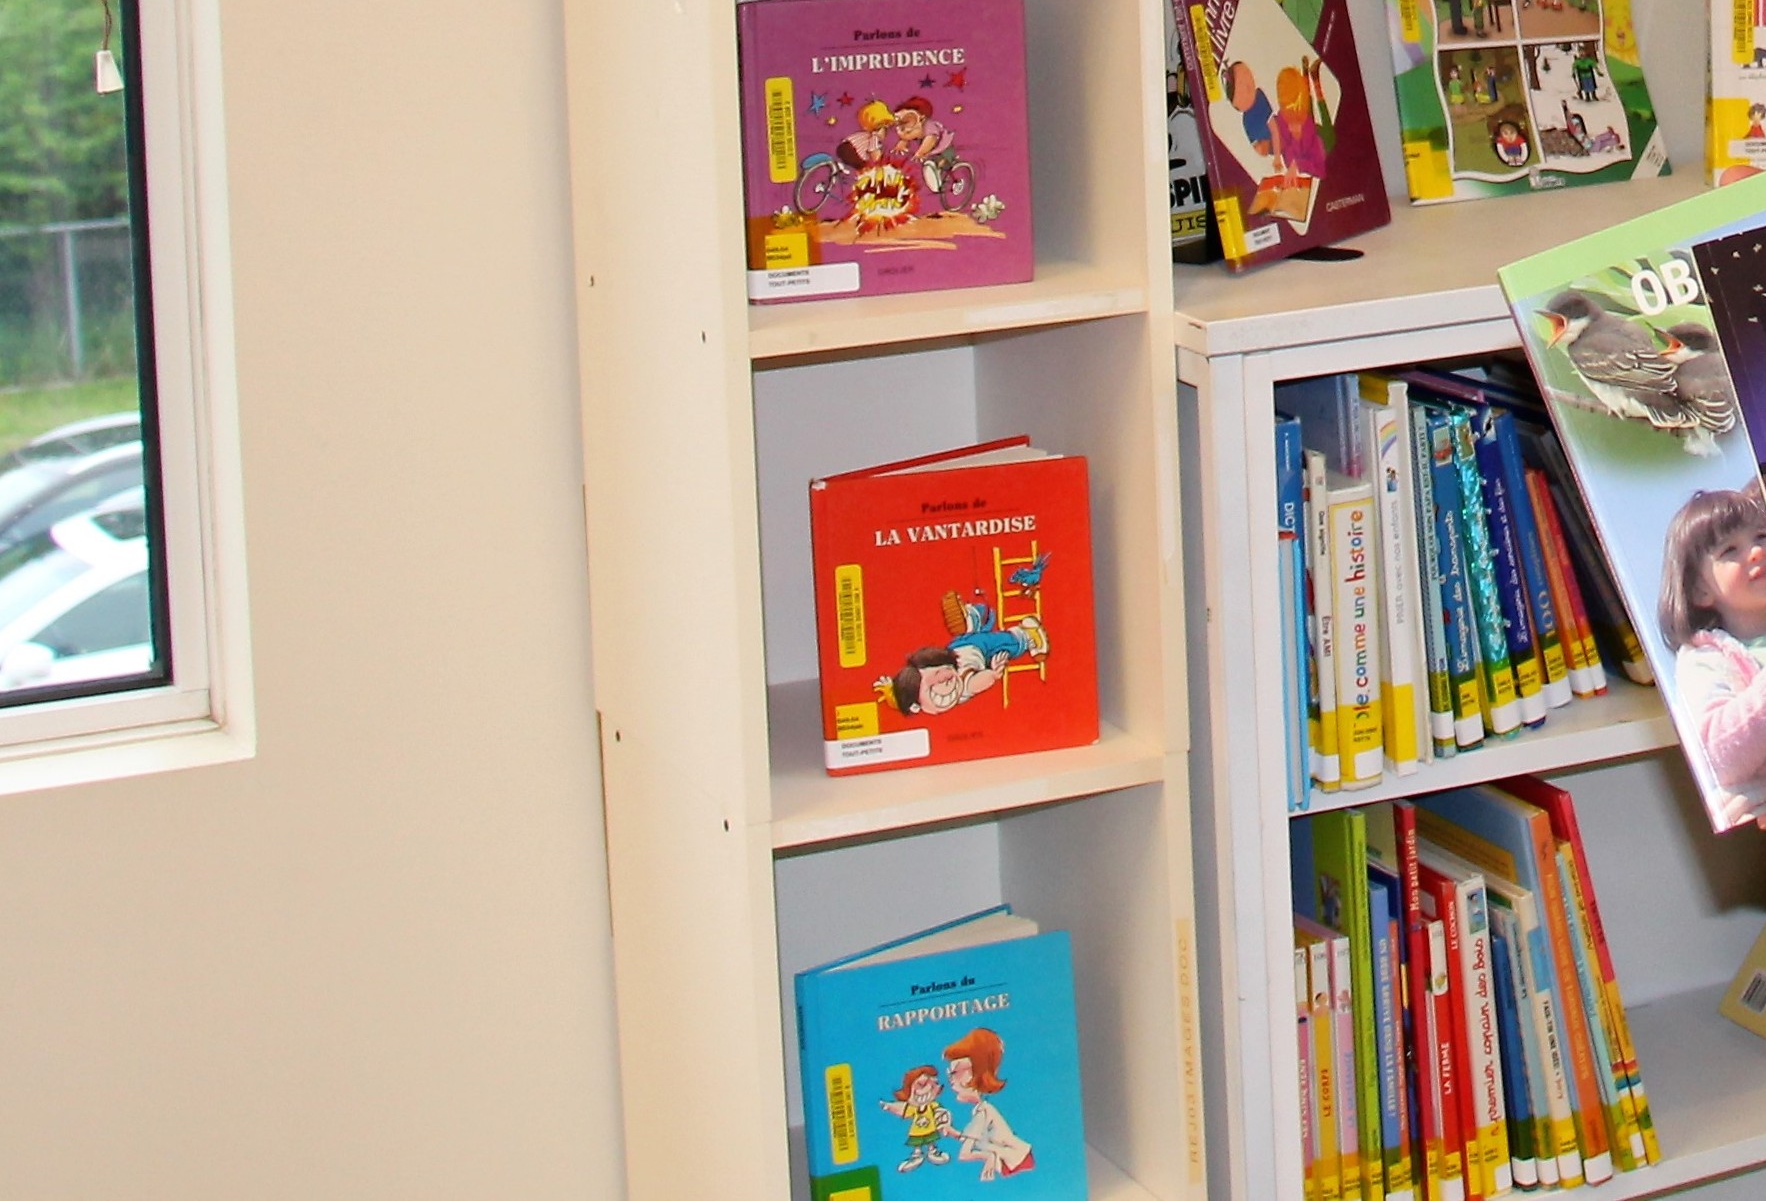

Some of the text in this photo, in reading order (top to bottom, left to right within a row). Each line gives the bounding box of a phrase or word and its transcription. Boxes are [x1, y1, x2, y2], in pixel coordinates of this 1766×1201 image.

[854, 28, 921, 42] Parlons de
[1210, 2, 1236, 51] livre
[811, 47, 966, 74] L'IMPRUDENCE
[921, 498, 987, 514] Parlons de
[875, 515, 1037, 547] LA VANTARDISE
[1346, 510, 1369, 687] comme une histoire
[910, 976, 976, 996] Parlons du
[1479, 972, 1491, 998] des
[877, 992, 1011, 1031] RAPPORTAGE
[1481, 1000, 1495, 1055] copain
[1443, 1080, 1453, 1094] LA
